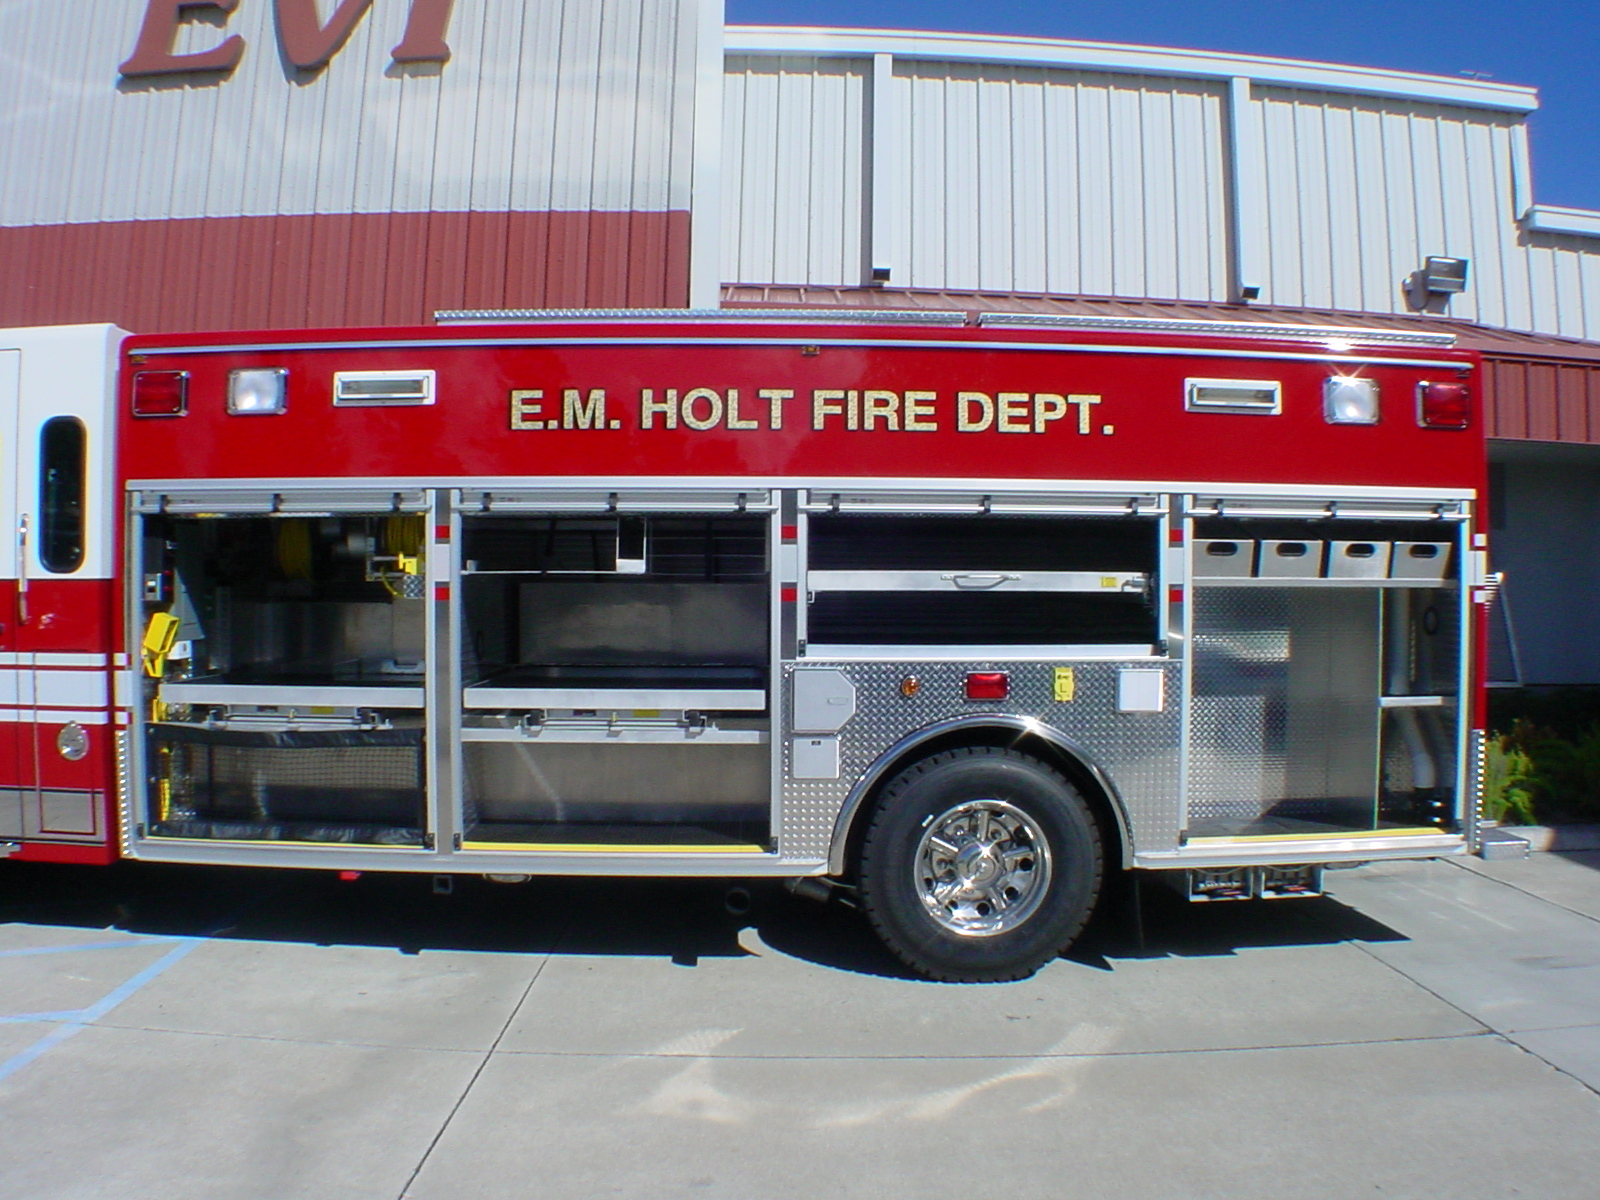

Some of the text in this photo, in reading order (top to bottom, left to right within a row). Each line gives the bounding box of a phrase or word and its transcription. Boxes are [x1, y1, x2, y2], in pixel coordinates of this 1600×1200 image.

[510, 387, 1115, 435] E.M. HOLT FIRE DEPT.
